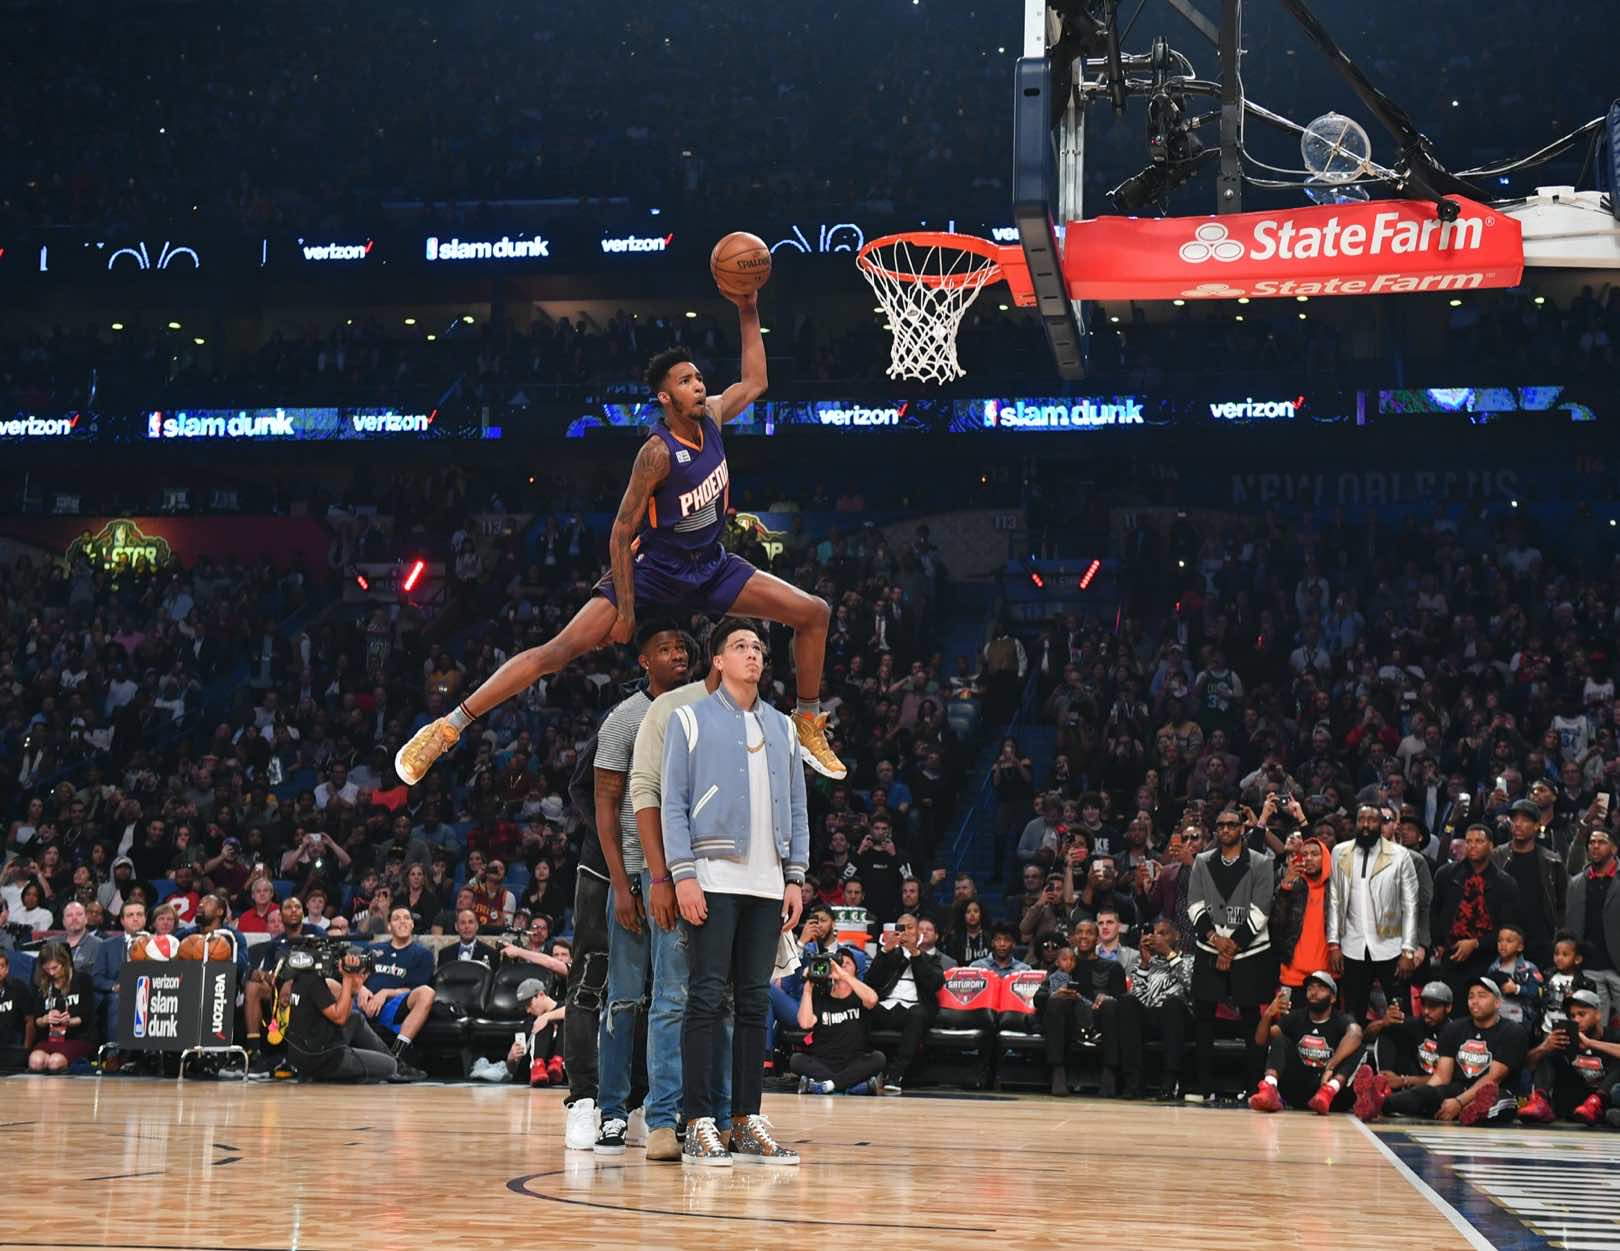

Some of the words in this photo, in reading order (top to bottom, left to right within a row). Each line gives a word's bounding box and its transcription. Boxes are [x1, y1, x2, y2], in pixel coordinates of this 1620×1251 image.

[302, 244, 364, 260] verizon
[601, 236, 664, 252] verizon
[819, 406, 898, 425] verizon
[1209, 398, 1293, 419] verizon
[353, 412, 427, 432] verizon
[151, 974, 180, 989] verizon
[149, 991, 179, 1014] slam
[212, 973, 227, 1033] verizon
[148, 1015, 178, 1037] dunk
